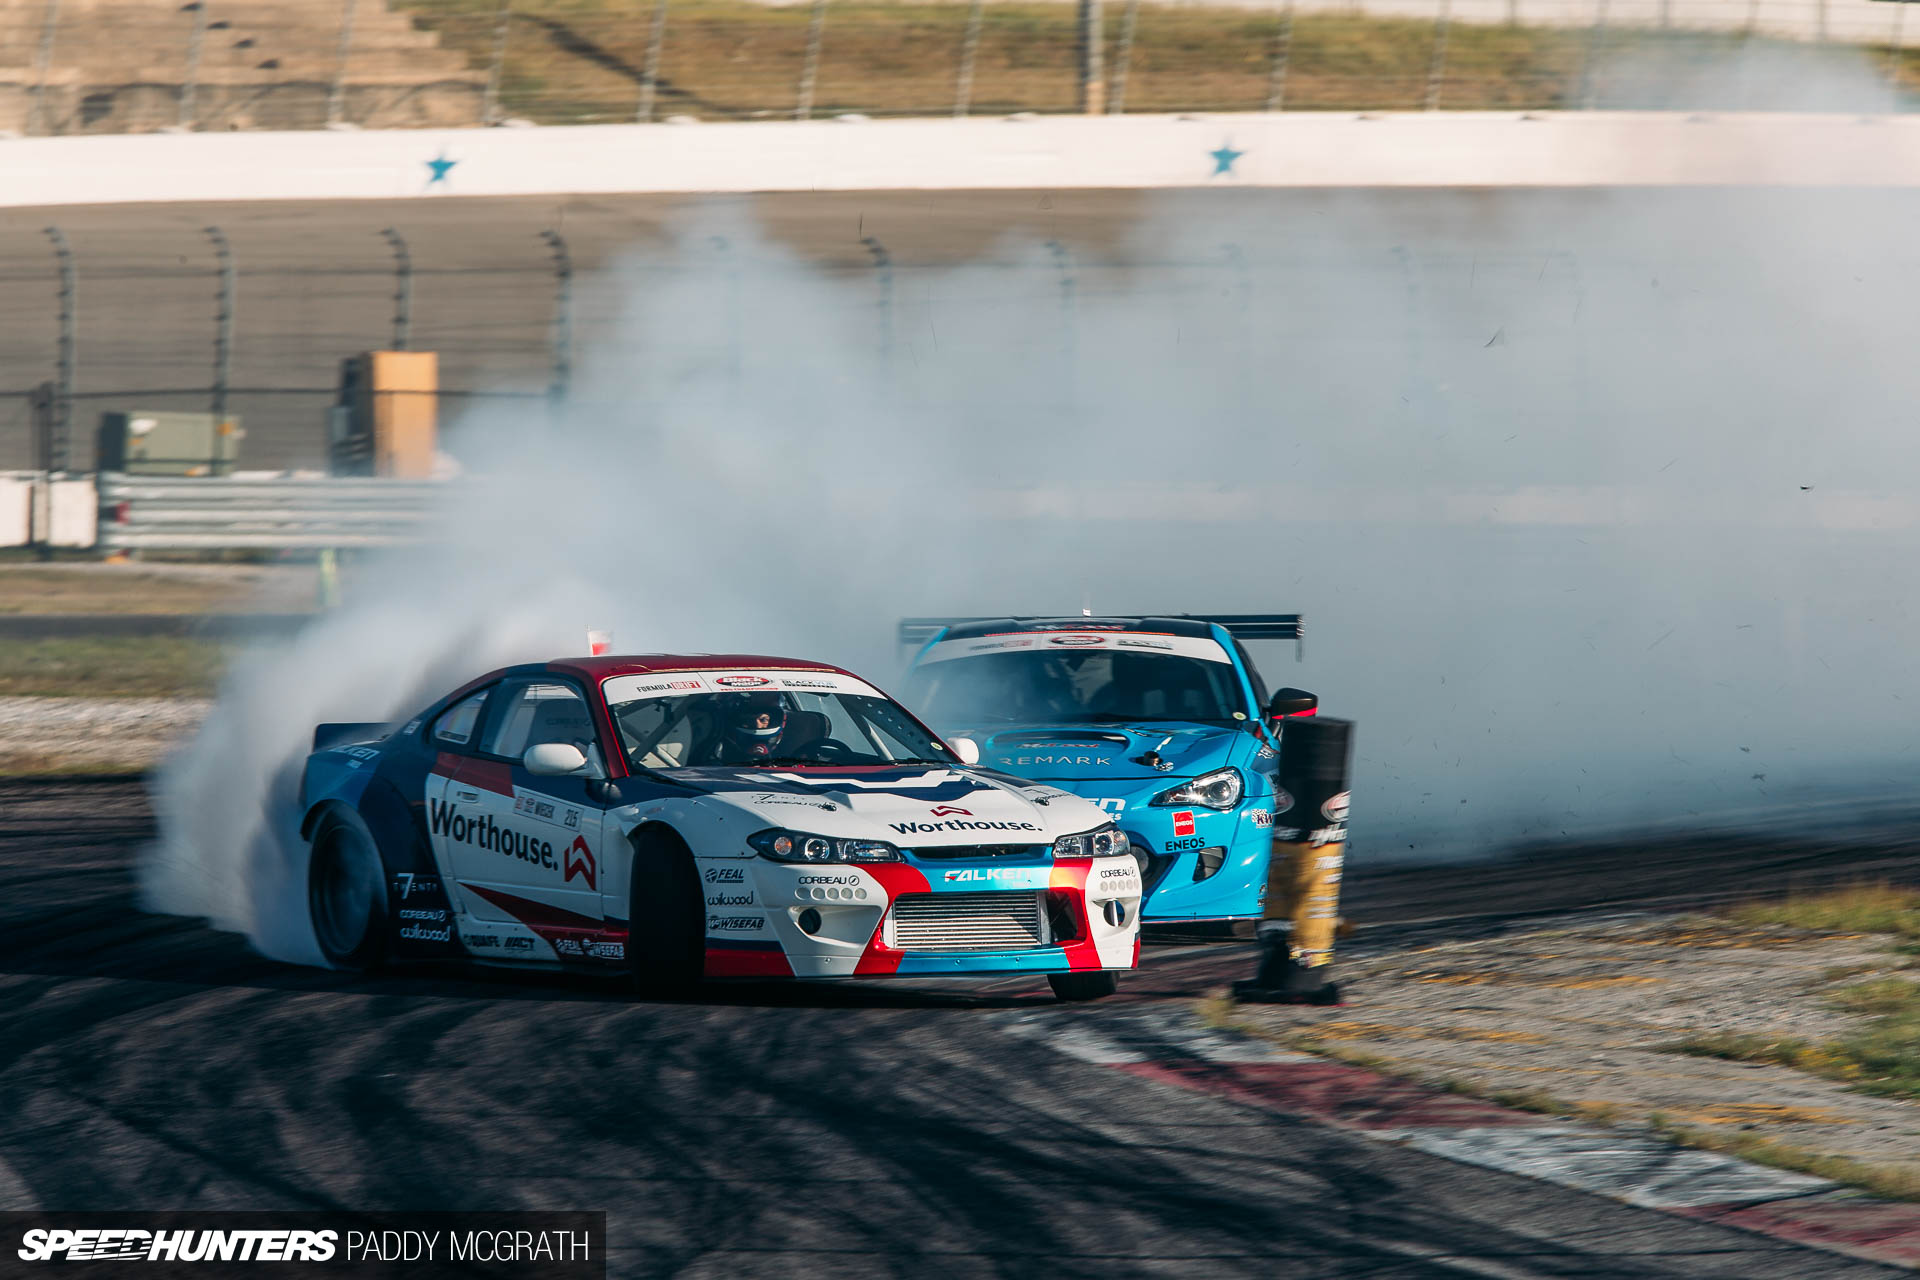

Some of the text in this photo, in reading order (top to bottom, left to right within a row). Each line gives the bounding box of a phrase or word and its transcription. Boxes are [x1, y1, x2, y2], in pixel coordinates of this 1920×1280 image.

[636, 680, 702, 692] FORMULA DRIFT
[888, 819, 1043, 835] Worthouse.
[431, 797, 559, 872] Worthouse.
[1165, 837, 1205, 852] ENEOS
[718, 868, 744, 879] FEAL
[941, 868, 1033, 882] FALKEN
[1100, 868, 1131, 879] CORBEAU
[798, 876, 847, 885] CORBEAU
[721, 918, 765, 929] WISEFAB
